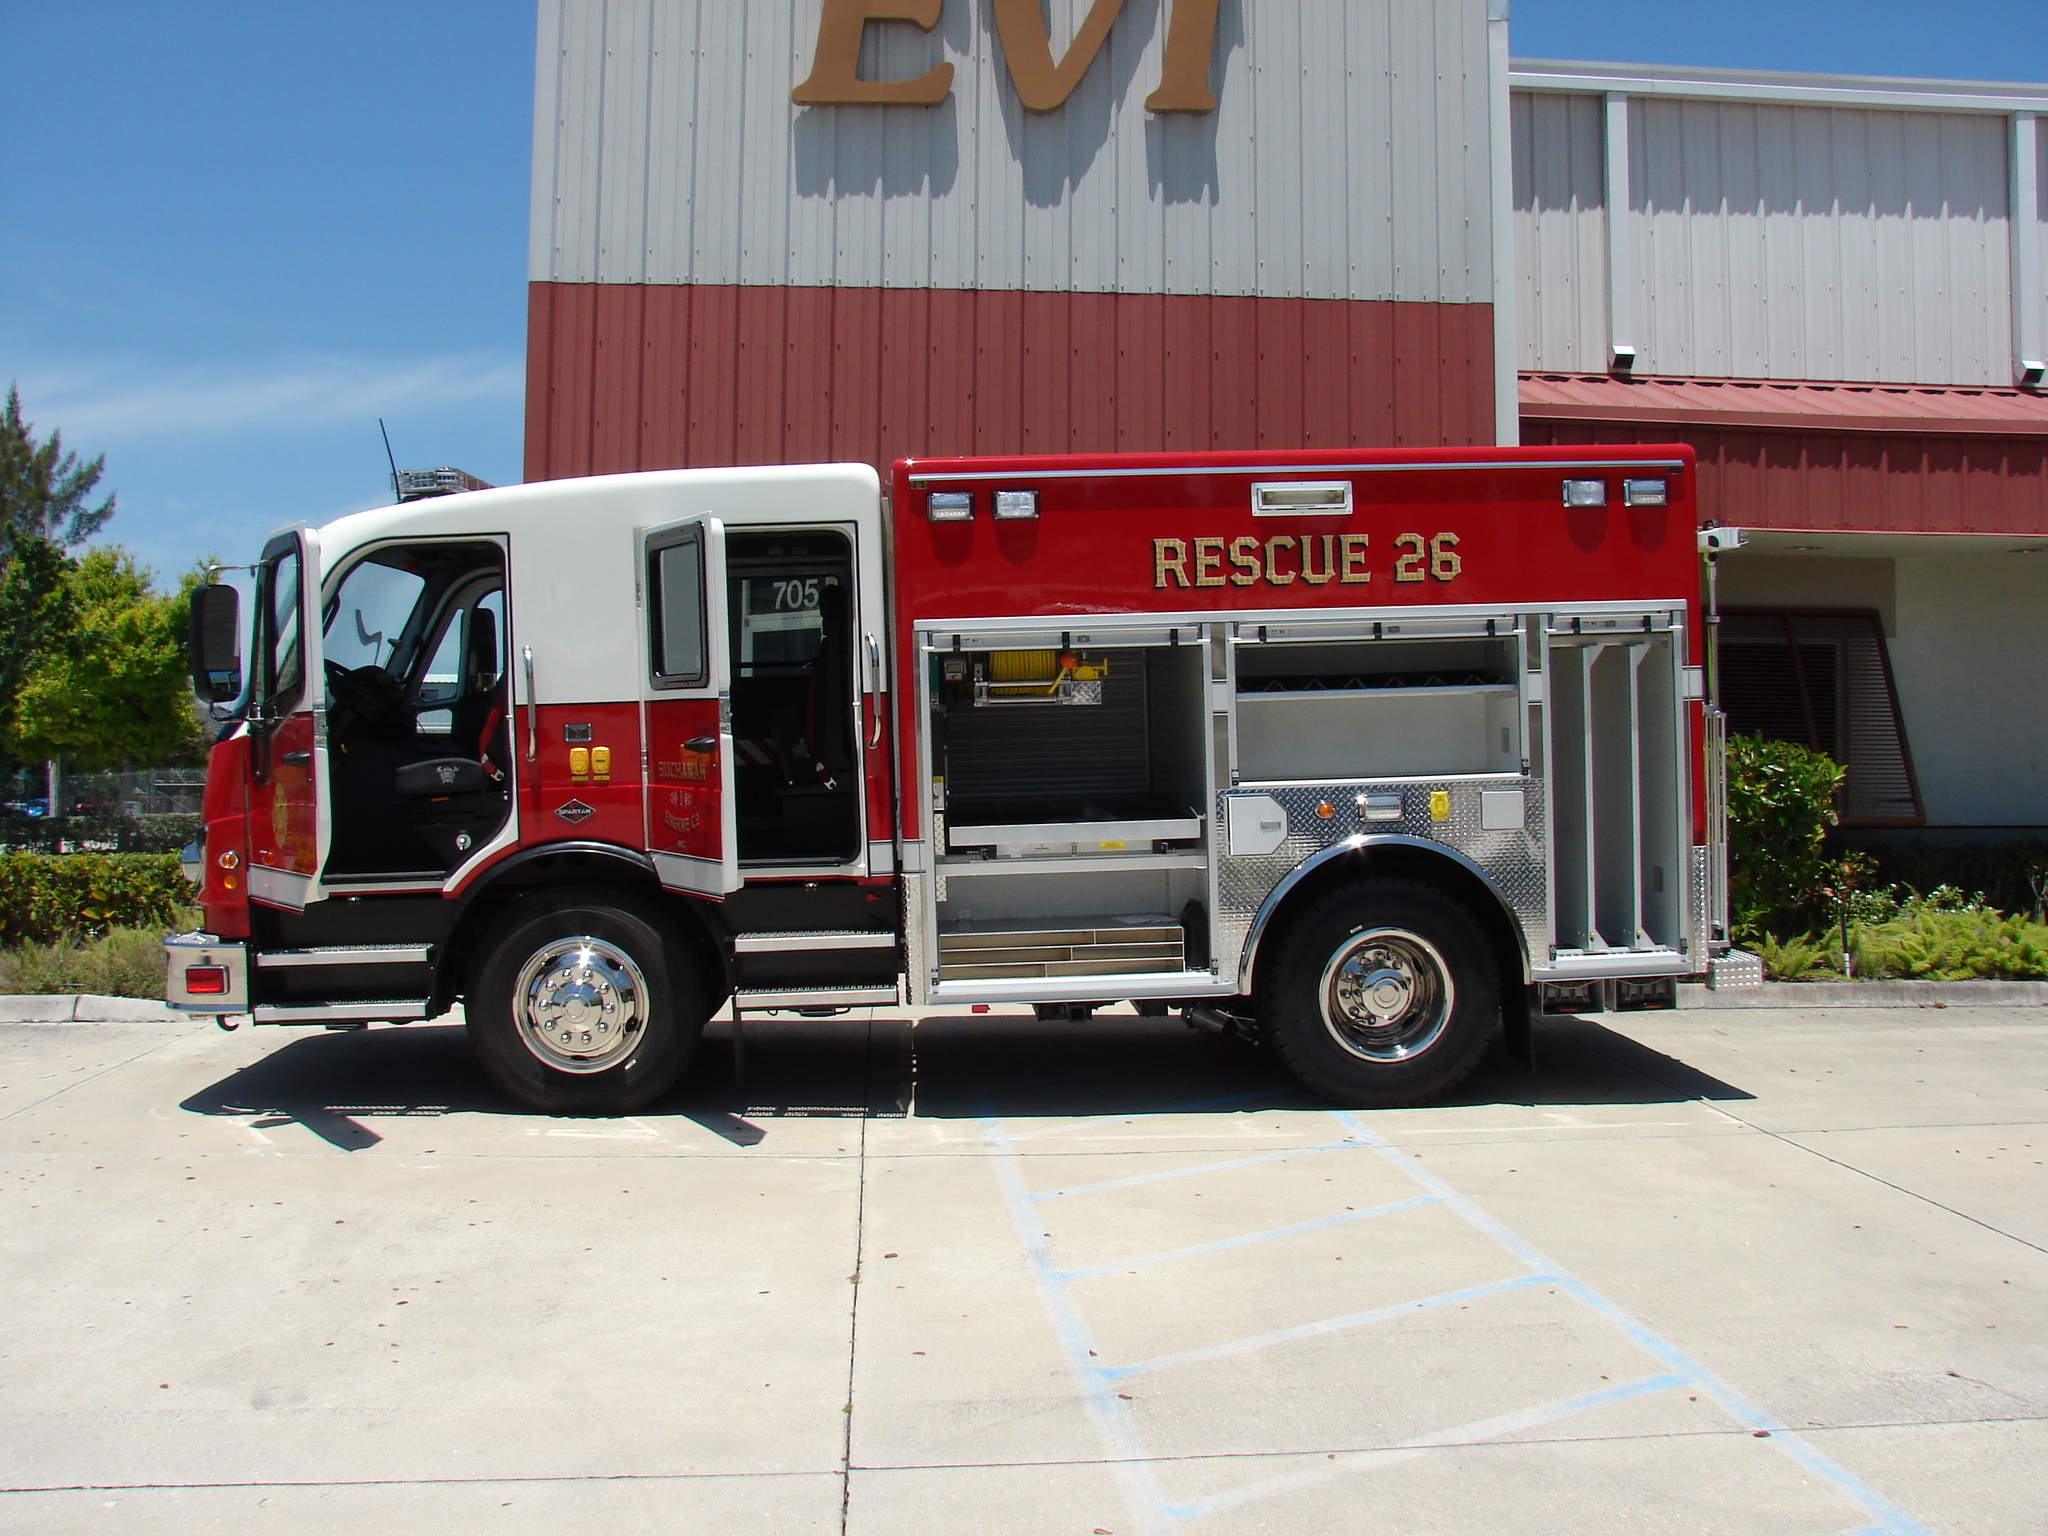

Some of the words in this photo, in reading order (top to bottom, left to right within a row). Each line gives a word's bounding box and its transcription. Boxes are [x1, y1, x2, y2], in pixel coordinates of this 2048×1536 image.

[1153, 533, 1371, 588] RESCUE
[1394, 532, 1462, 582] 26
[773, 579, 820, 610] 705
[658, 761, 706, 780] BUCHANAN
[664, 809, 690, 832] ENGINE
